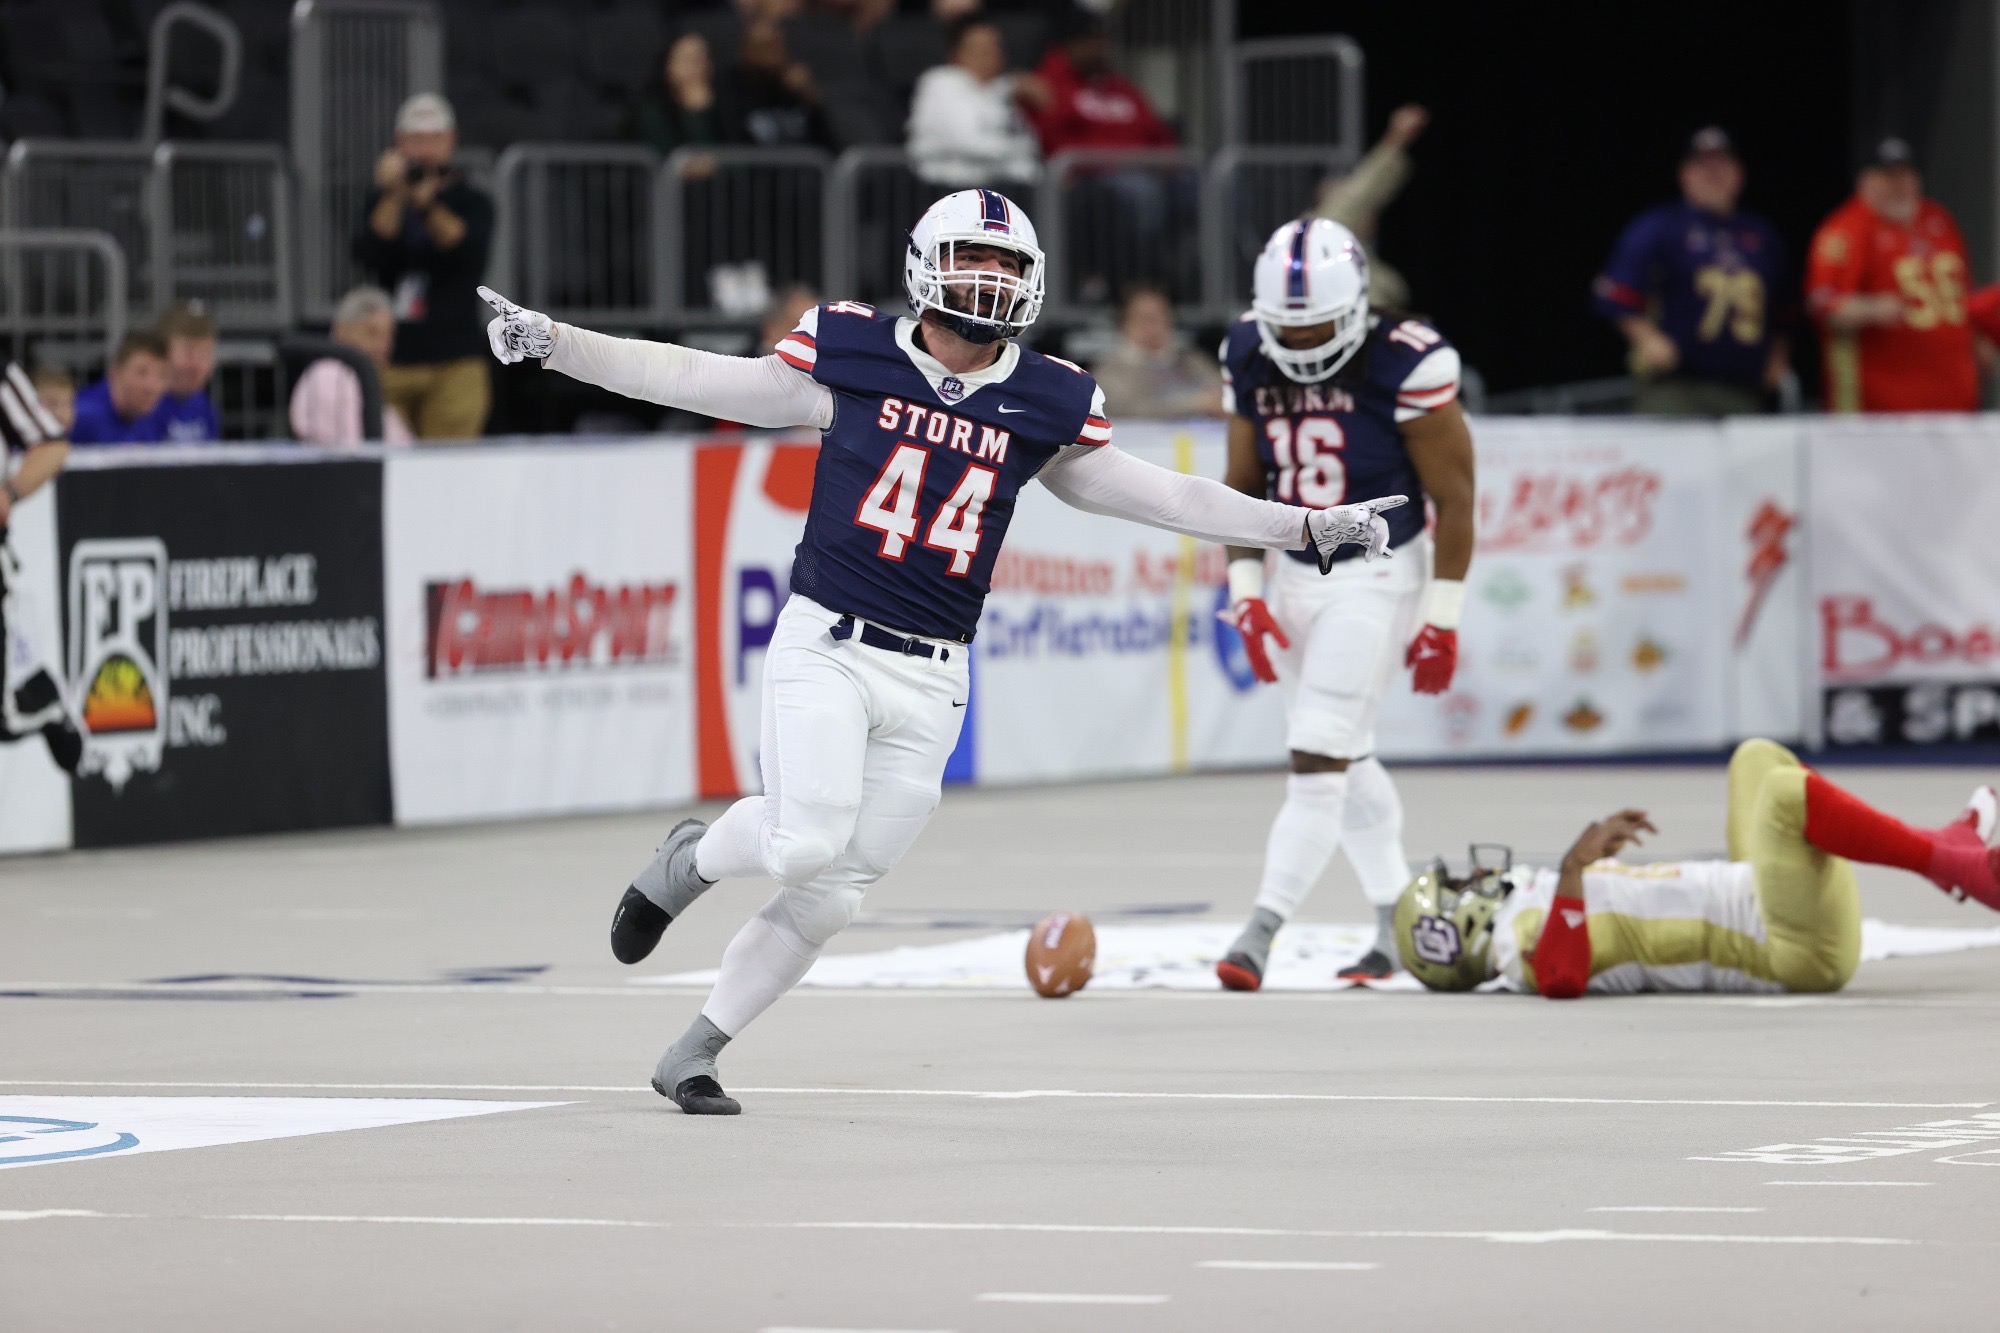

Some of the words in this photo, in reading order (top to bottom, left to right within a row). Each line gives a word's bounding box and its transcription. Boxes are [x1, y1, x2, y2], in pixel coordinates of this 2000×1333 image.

[1389, 320, 1441, 352] 16
[1694, 267, 1764, 345] 79
[943, 380, 961, 391] IFL
[878, 397, 1010, 463] STORM
[1265, 414, 1346, 510] 16
[854, 441, 1000, 577] 44
[169, 553, 317, 611] FIREPLACE
[169, 615, 380, 679] PROFESSIONALS
[169, 693, 227, 748] INC.
